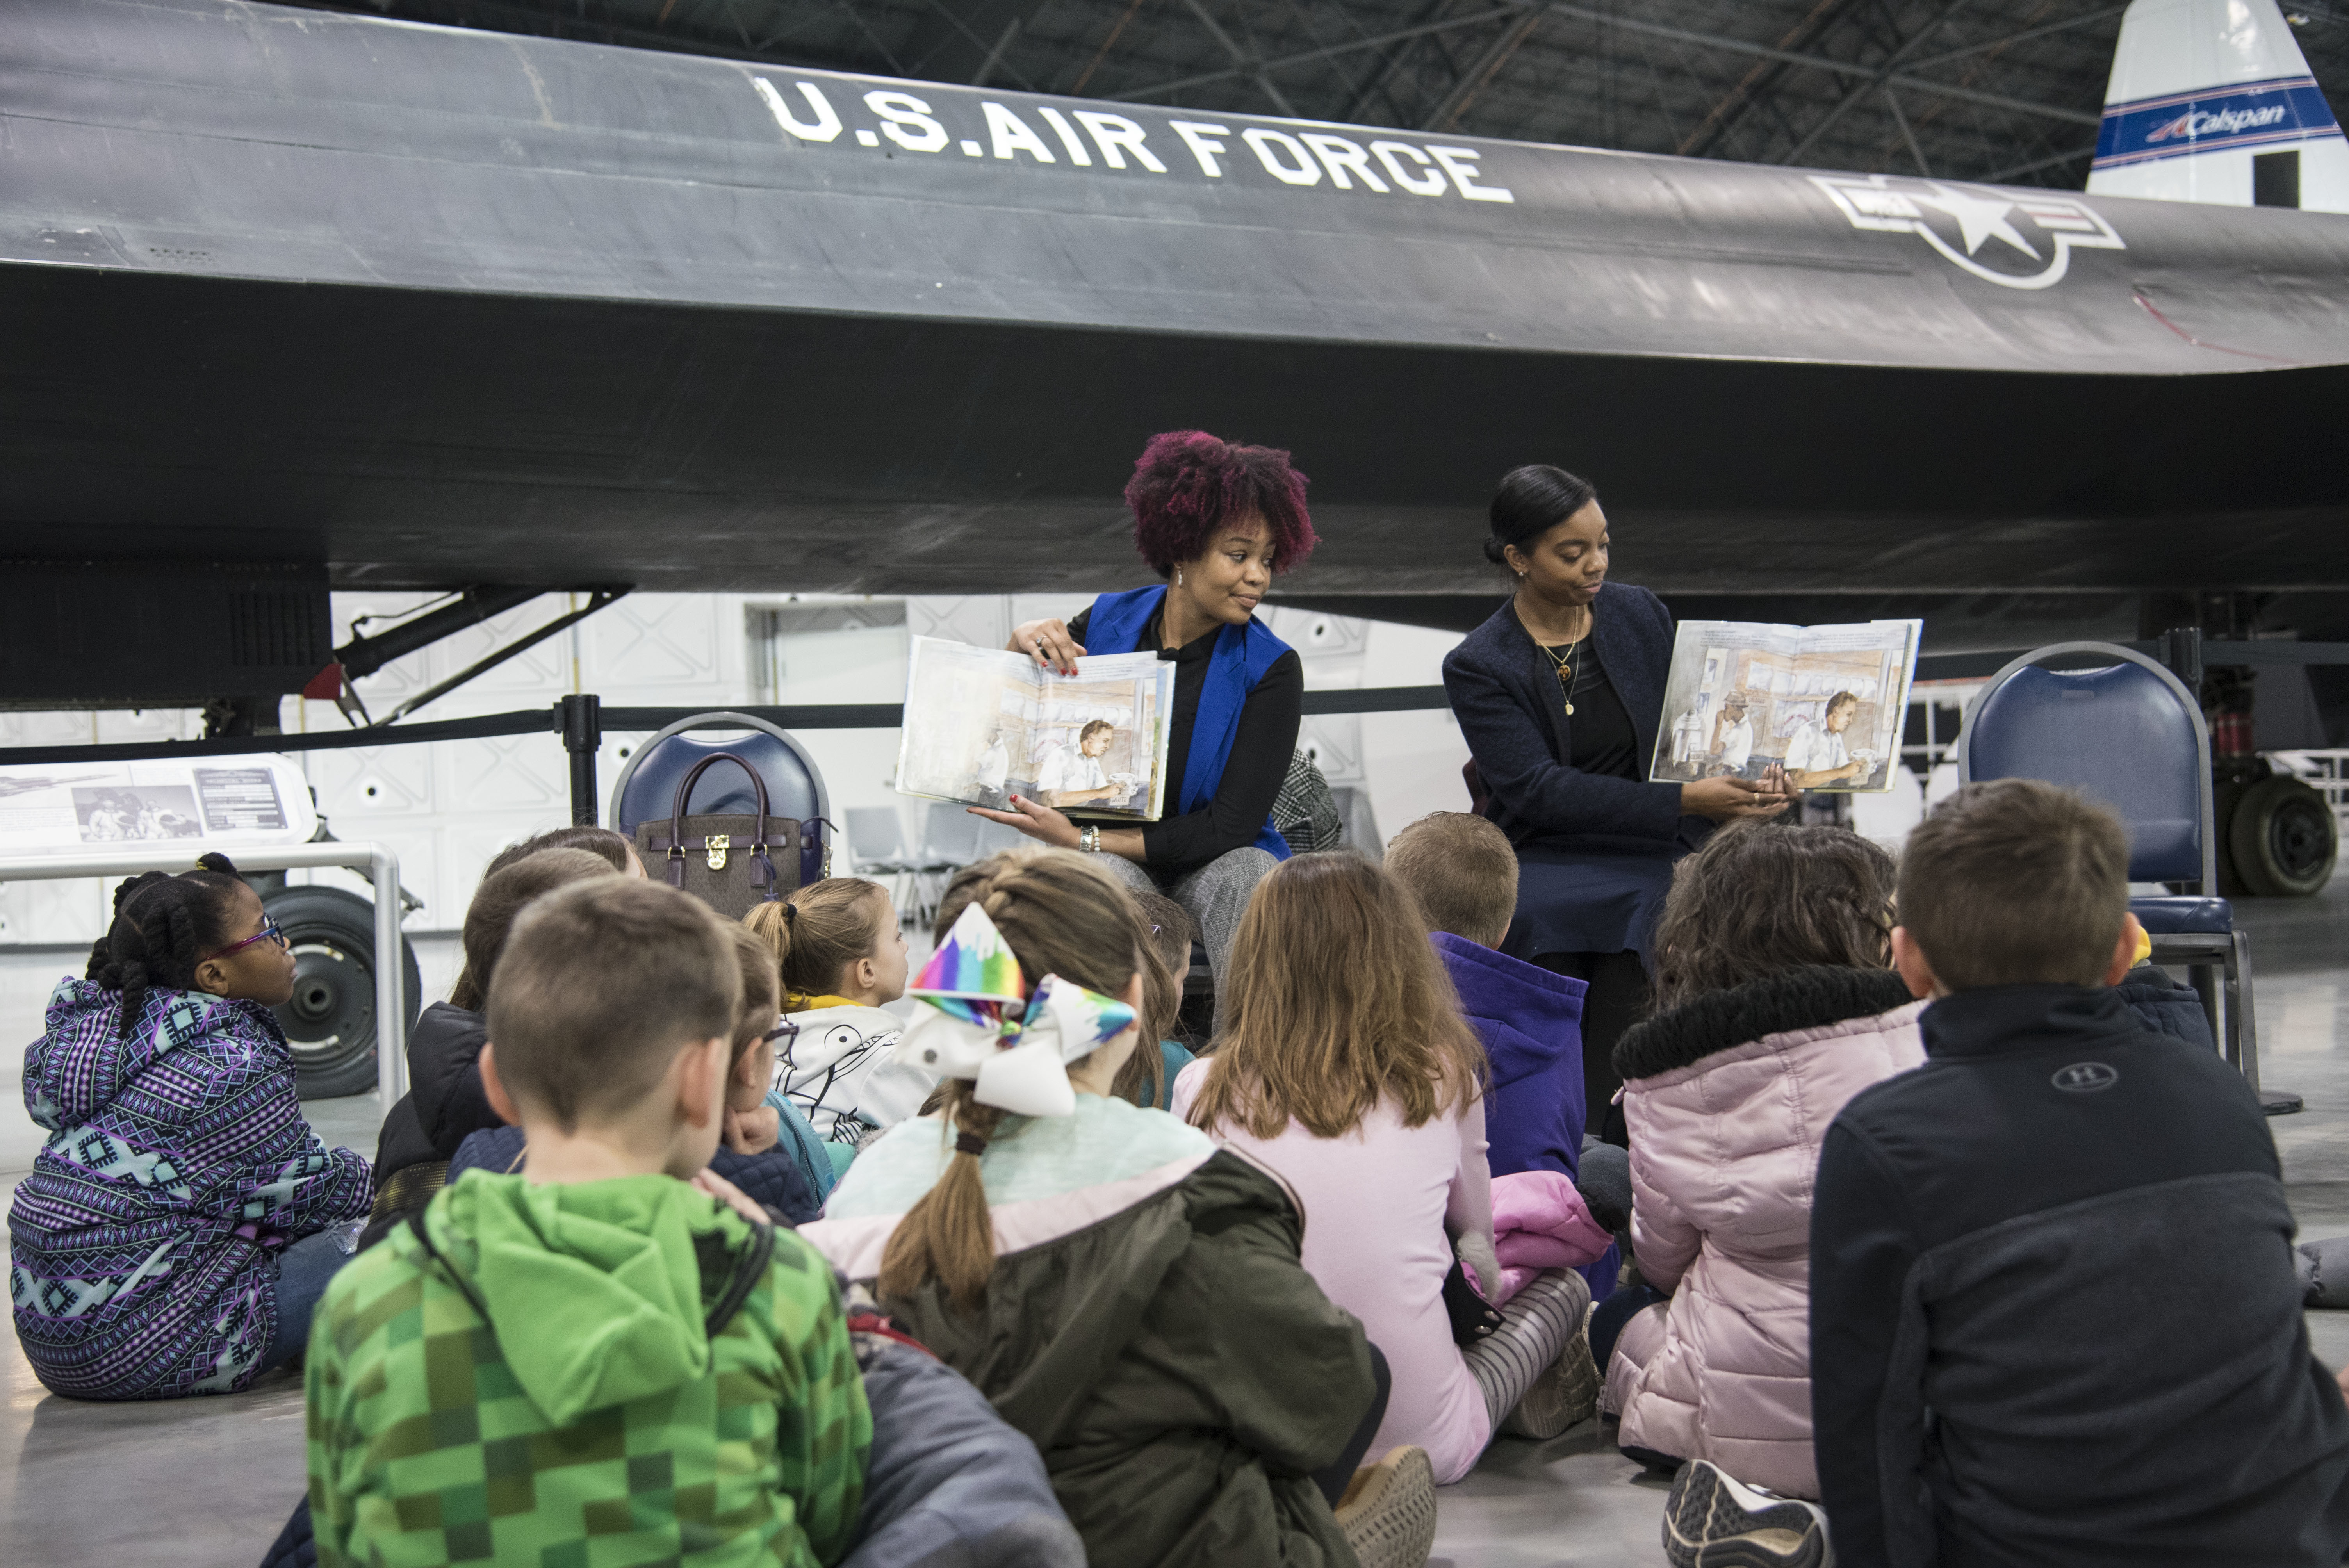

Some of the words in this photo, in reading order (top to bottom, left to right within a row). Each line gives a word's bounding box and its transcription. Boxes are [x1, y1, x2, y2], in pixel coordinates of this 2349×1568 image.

[981, 101, 1167, 173] AIR
[1168, 120, 1515, 203] FORCE
[2186, 105, 2285, 136] Calspan
